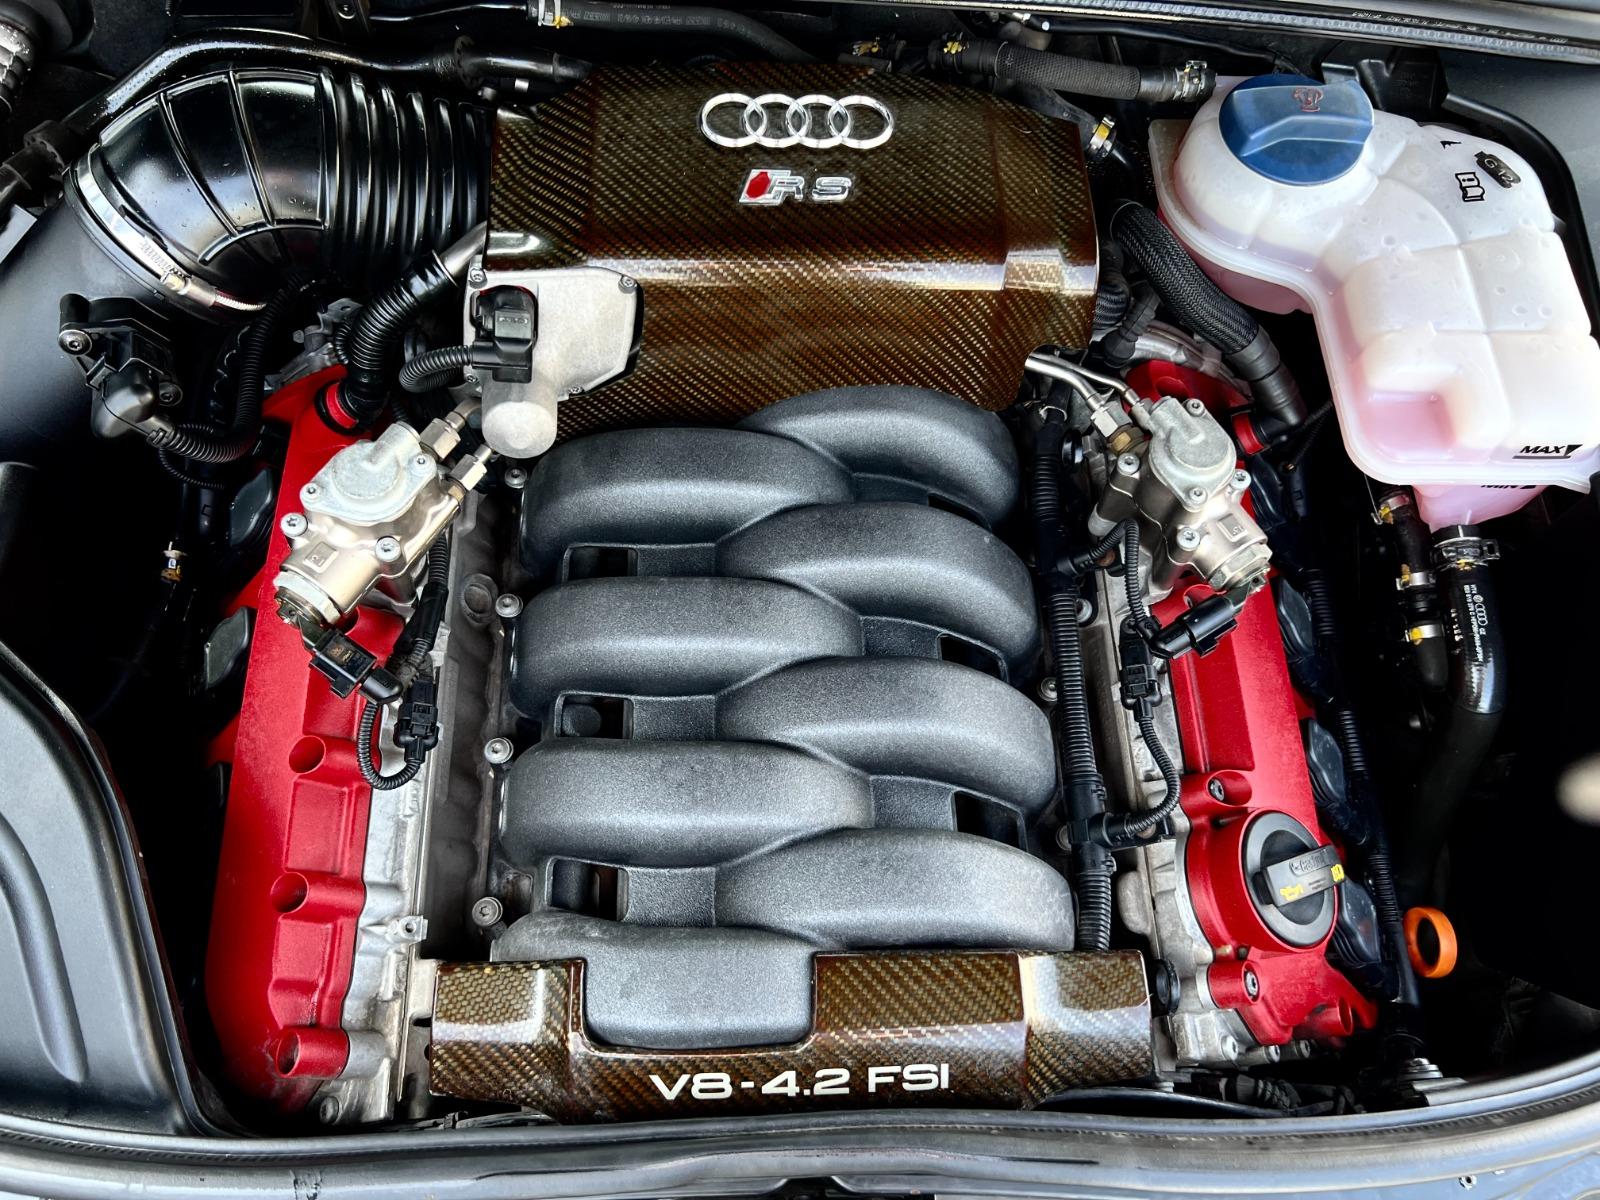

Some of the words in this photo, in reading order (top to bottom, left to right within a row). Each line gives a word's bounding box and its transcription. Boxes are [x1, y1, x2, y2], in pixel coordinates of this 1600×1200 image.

[763, 174, 852, 202] RS
[1520, 445, 1566, 454] MAX
[868, 1062, 950, 1093] FSI
